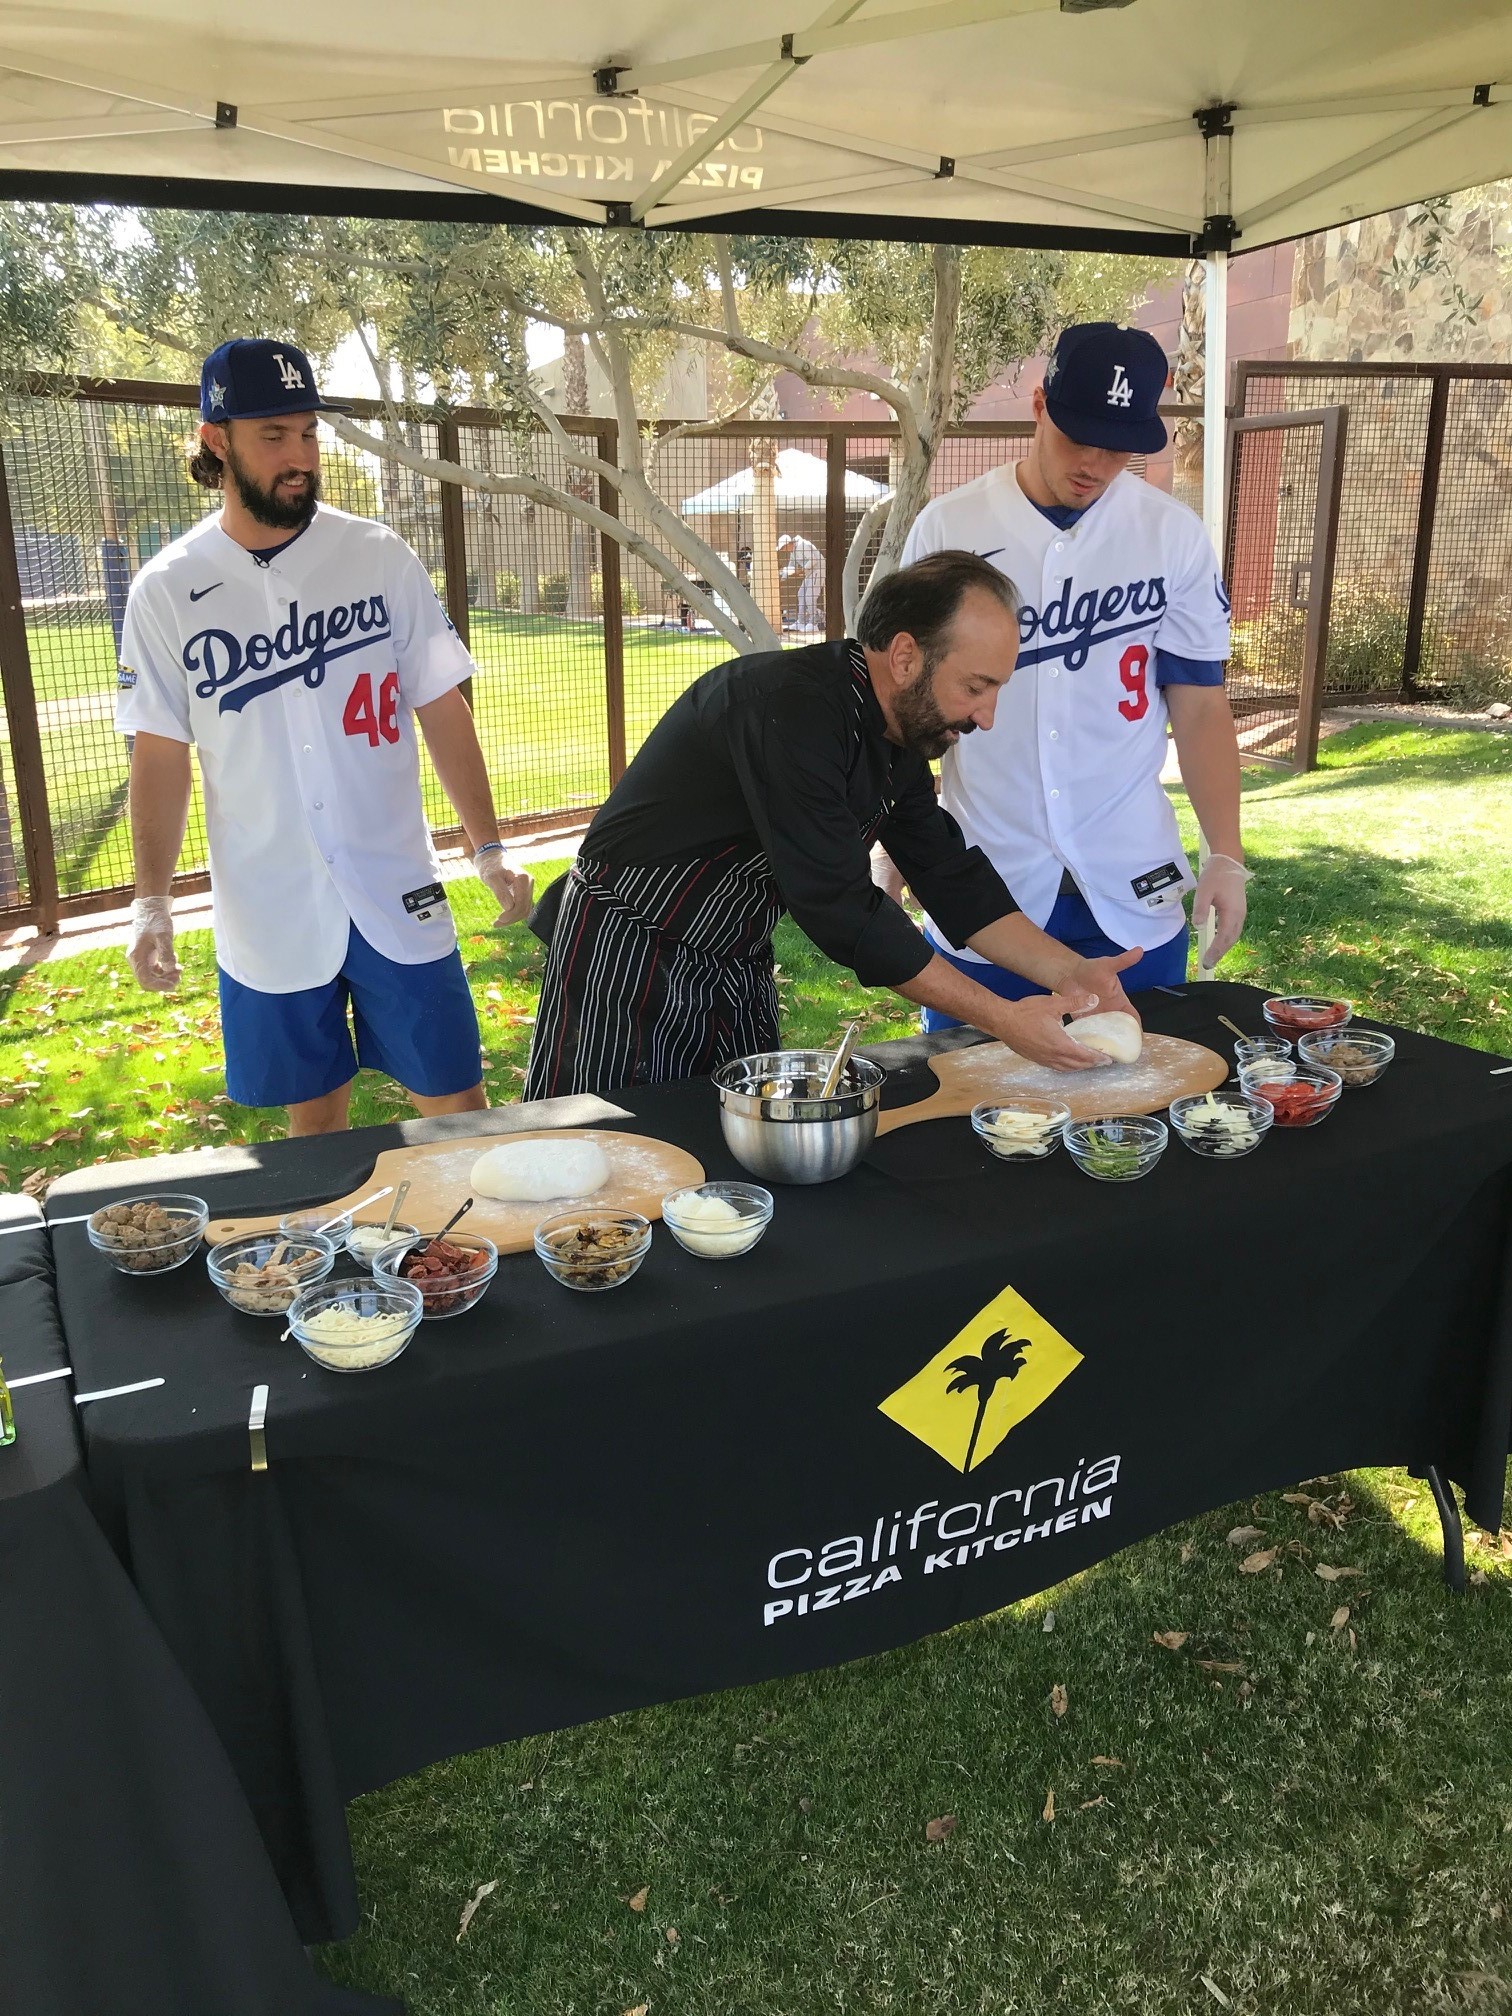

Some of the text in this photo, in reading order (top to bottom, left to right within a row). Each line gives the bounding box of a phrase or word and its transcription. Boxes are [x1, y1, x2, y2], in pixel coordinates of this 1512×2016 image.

[273, 354, 305, 389] LA
[1107, 365, 1133, 407] LA
[183, 594, 391, 714] Dodgers
[1016, 576, 1168, 671] odgers
[343, 672, 400, 747] 46
[1118, 644, 1149, 722] 9
[763, 1495, 1113, 1627] PIZZA KITCHEN
[767, 1454, 1121, 1589] california
